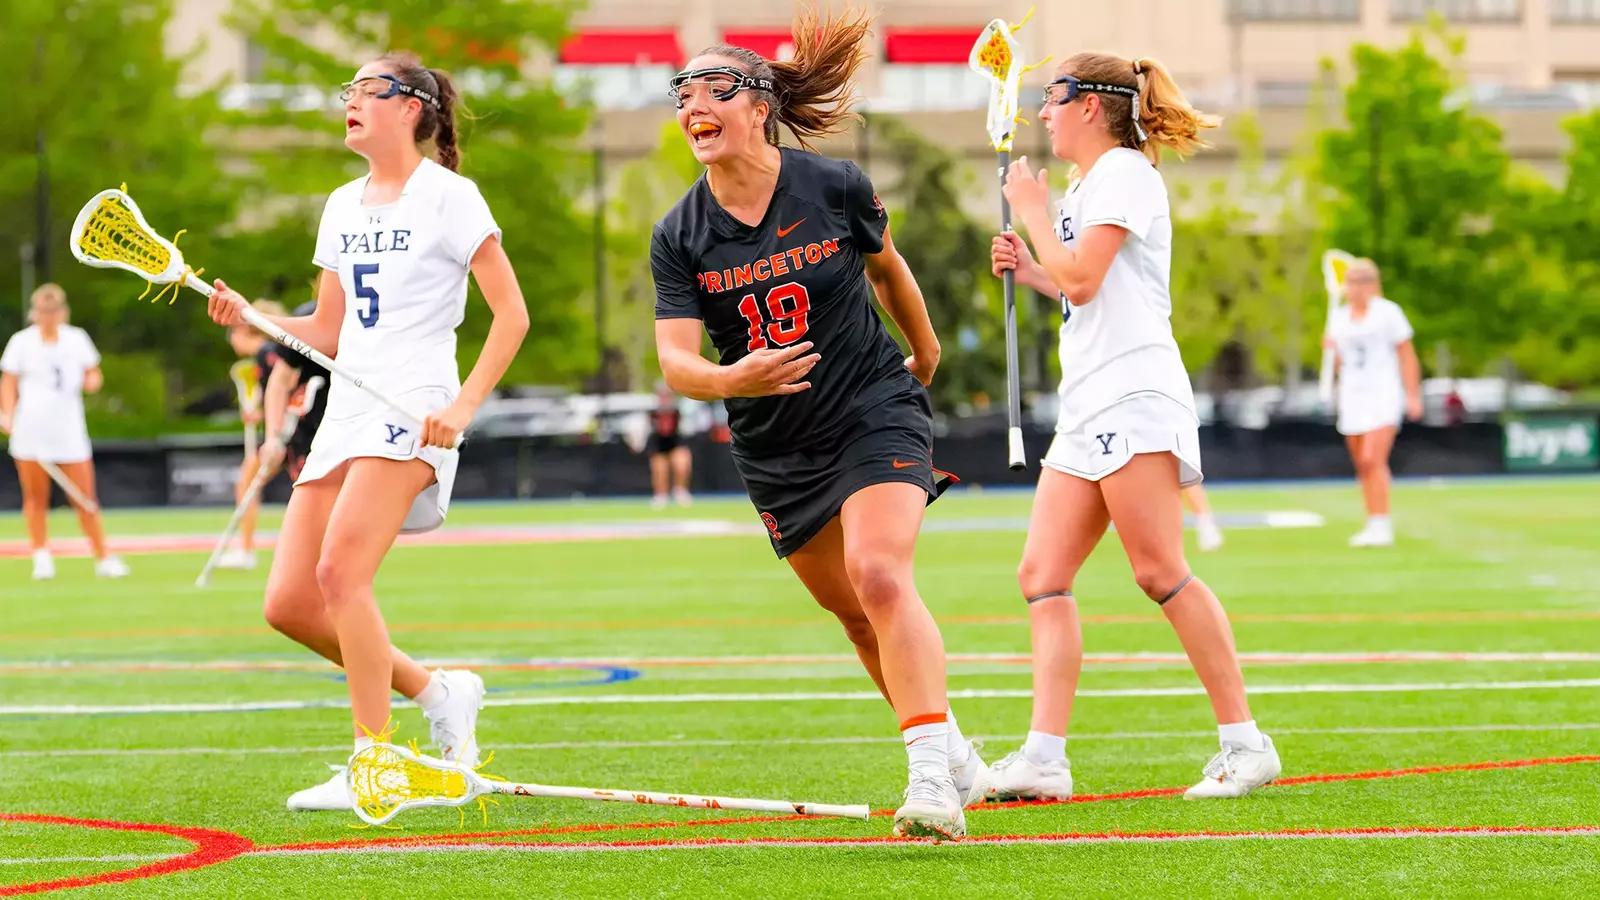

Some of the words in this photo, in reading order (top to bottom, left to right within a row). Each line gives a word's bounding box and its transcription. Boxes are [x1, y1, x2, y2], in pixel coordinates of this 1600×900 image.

[340, 229, 411, 254] YALE
[353, 263, 380, 329] 5
[738, 281, 811, 353] 19
[385, 423, 408, 445] Y
[1096, 432, 1116, 455] Y
